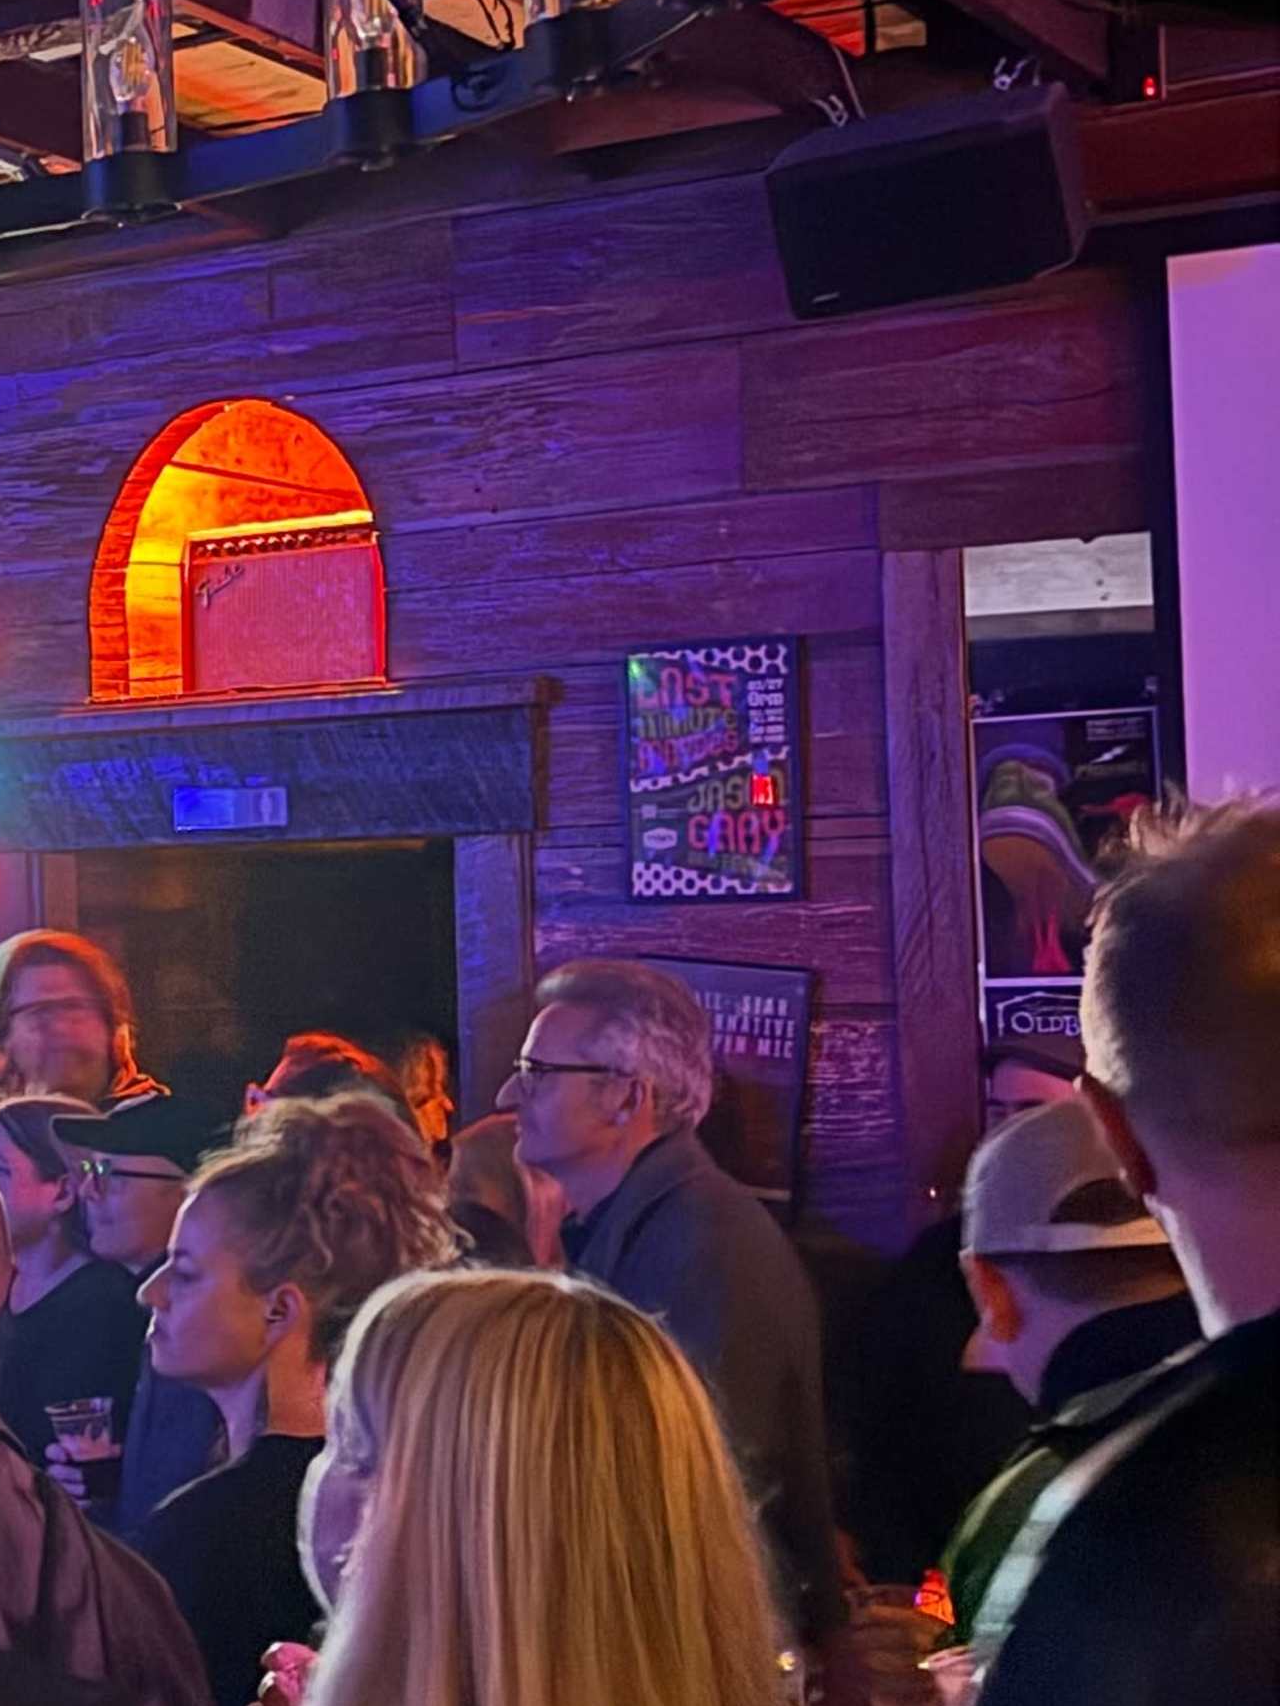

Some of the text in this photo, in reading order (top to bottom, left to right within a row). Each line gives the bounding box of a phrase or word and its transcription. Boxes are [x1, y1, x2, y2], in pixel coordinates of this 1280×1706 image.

[636, 668, 738, 708] LAST
[1011, 1011, 1081, 1036] OLDB
[757, 1038, 794, 1059] MIC
